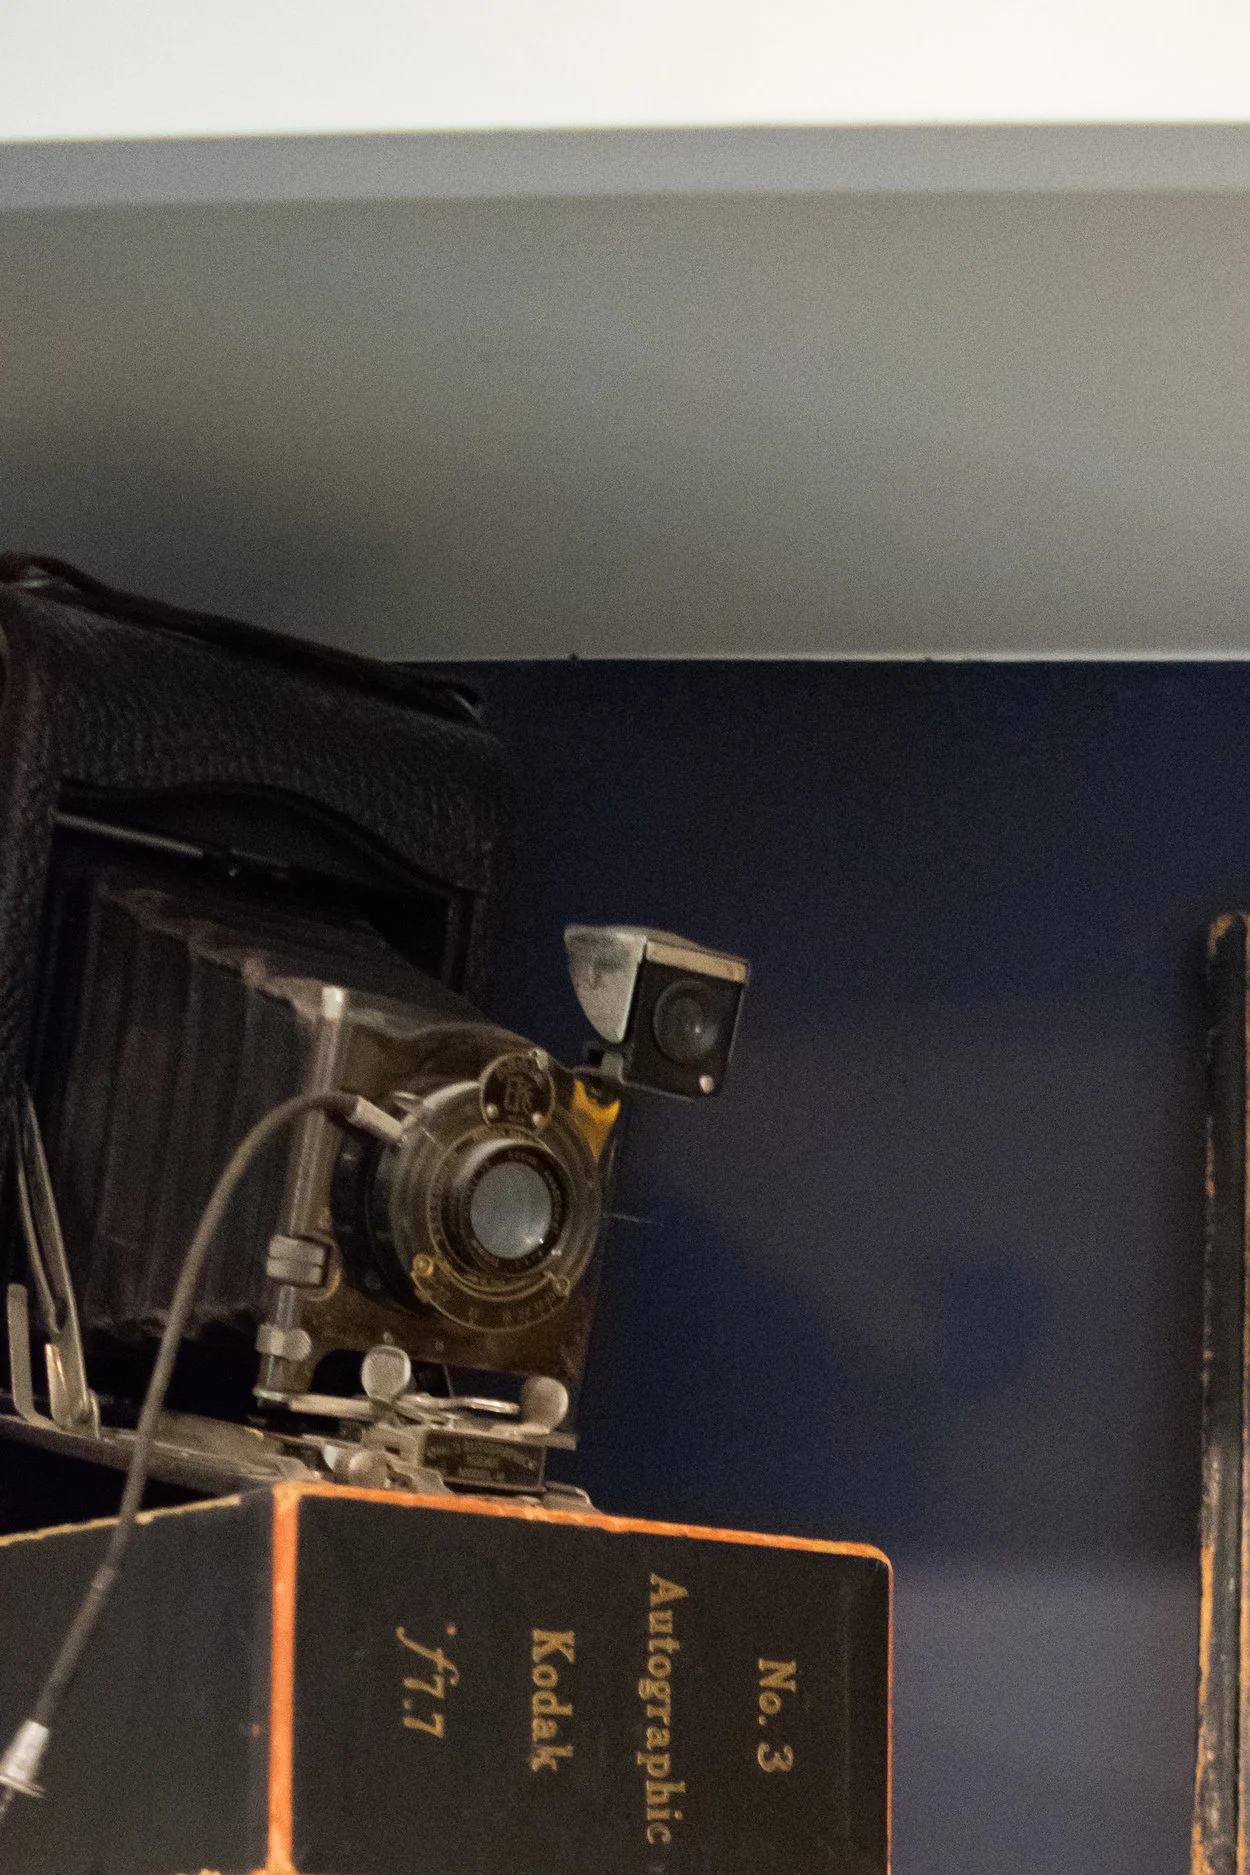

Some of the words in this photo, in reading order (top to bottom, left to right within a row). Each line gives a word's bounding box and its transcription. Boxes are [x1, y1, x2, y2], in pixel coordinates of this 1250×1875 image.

[530, 1628, 576, 1773] Kodak
[636, 1572, 690, 1845] Autographic
[757, 1658, 797, 1729] No.
[756, 1743, 795, 1774] 3
